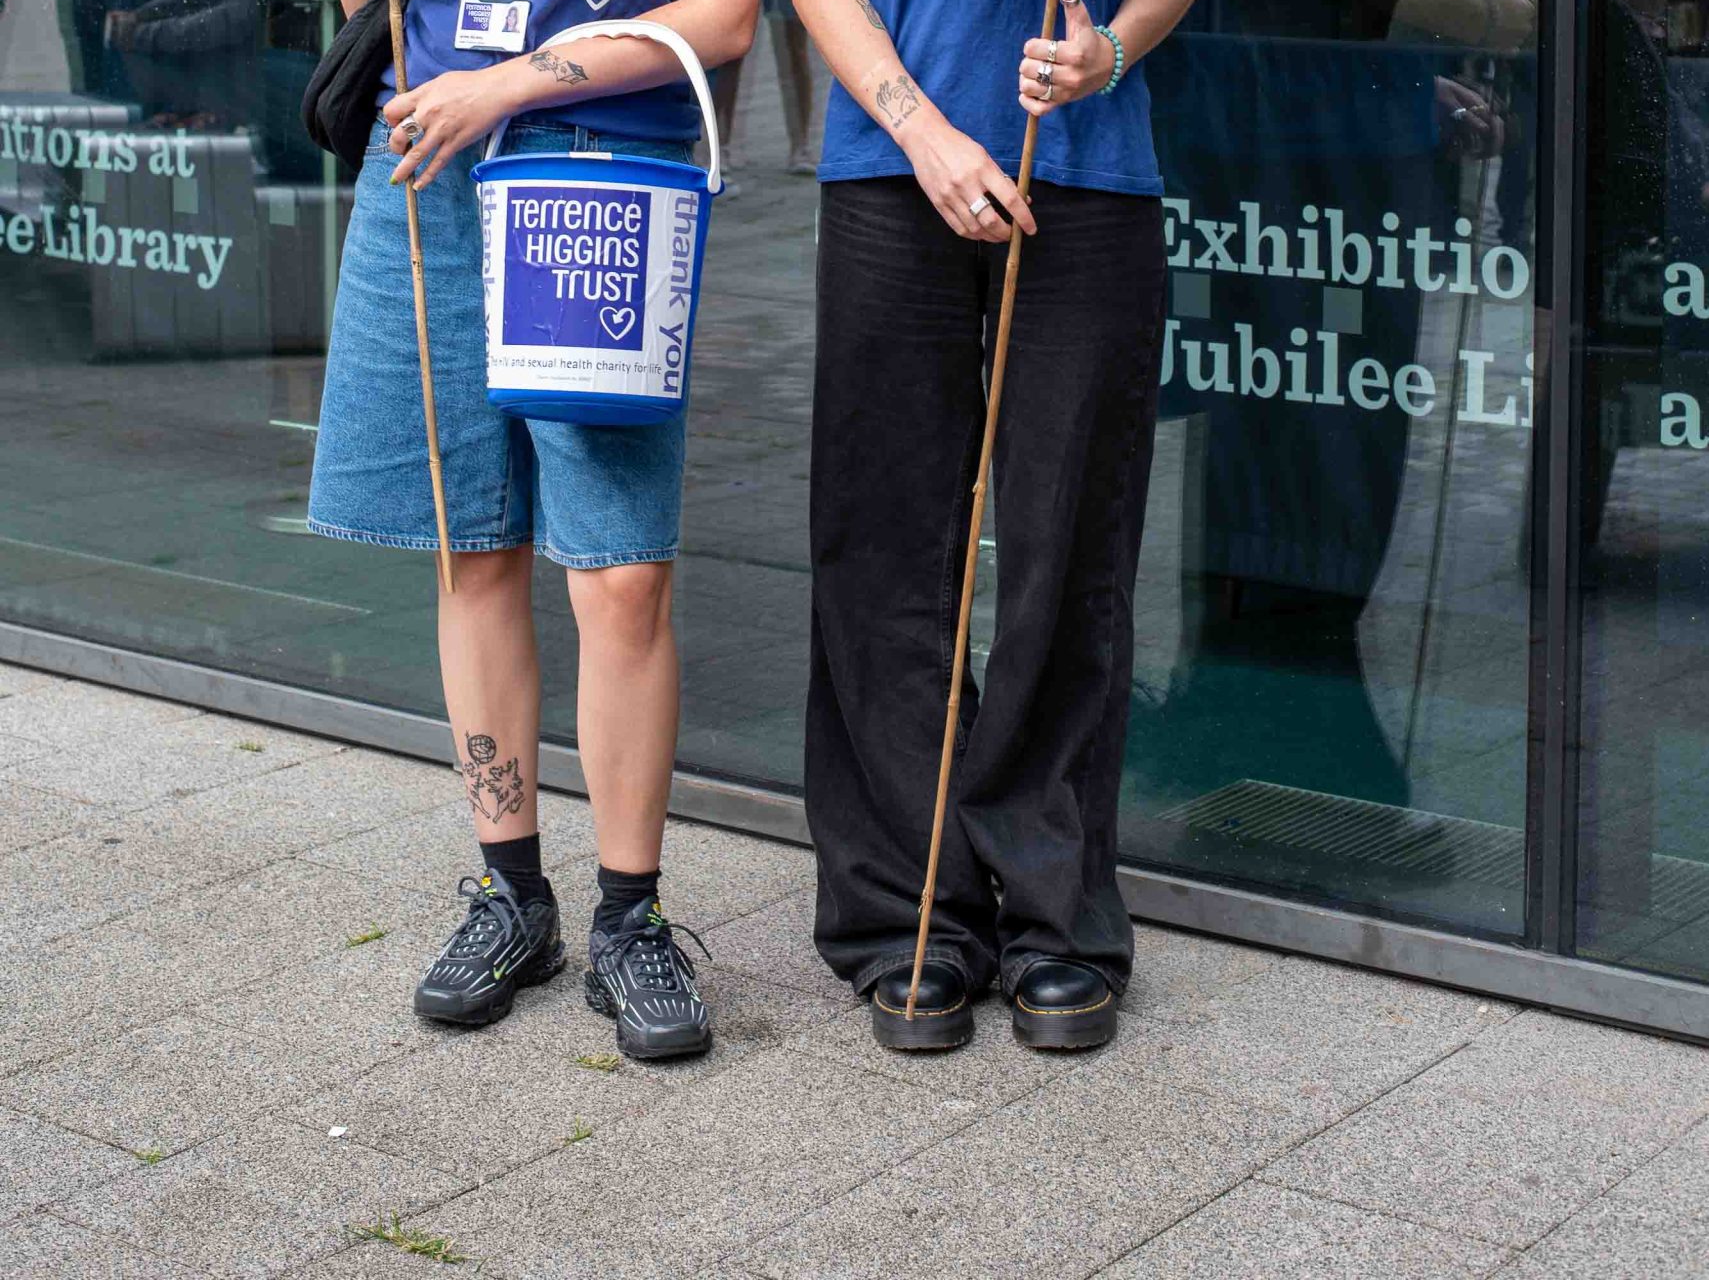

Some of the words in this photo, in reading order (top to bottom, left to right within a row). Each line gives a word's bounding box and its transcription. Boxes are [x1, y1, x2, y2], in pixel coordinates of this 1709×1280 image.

[149, 127, 195, 178] at
[511, 198, 642, 233] Terrence
[40, 204, 233, 289] Library
[669, 193, 698, 308] thank
[527, 356, 556, 368] sexual
[560, 357, 592, 370] health
[596, 359, 631, 373] charity
[634, 361, 646, 373] for
[649, 363, 662, 375] life
[659, 322, 684, 394] you
